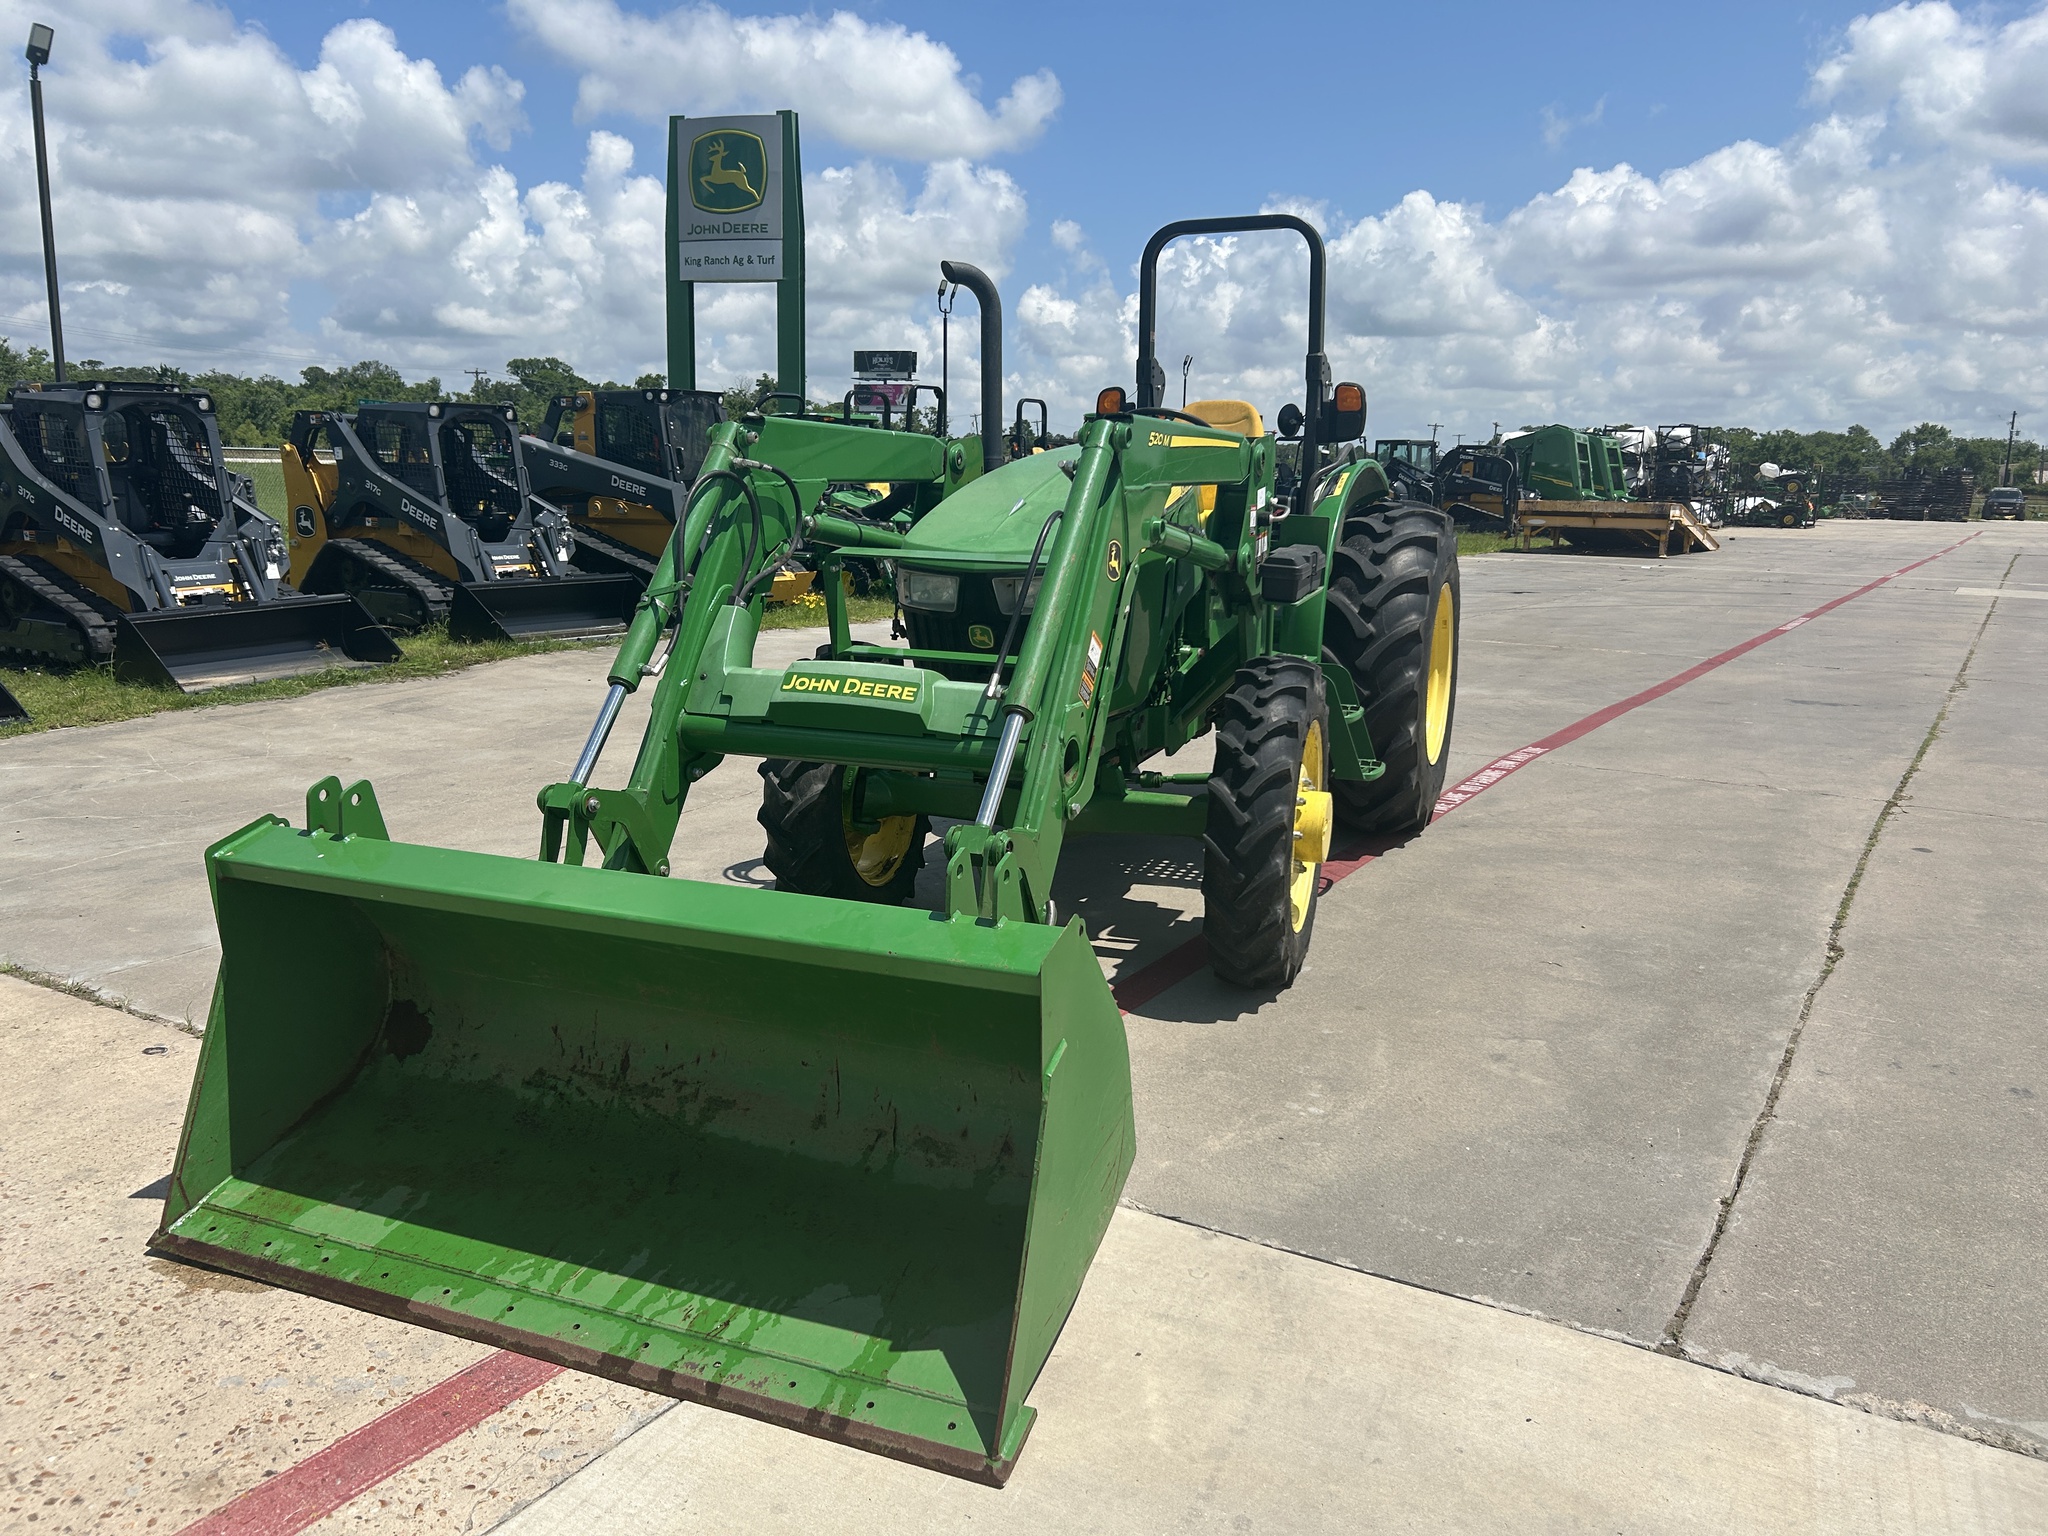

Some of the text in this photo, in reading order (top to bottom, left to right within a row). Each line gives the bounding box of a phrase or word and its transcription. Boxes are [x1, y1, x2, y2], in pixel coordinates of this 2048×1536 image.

[687, 222, 768, 235] JOHN DEERE
[684, 254, 776, 267] King Ranch Ag & Turf
[549, 459, 568, 471] 333G
[17, 485, 35, 504] 317G
[364, 480, 382, 496] 317G
[611, 475, 647, 497] DEERE
[401, 498, 438, 530] DEERE
[54, 505, 93, 544] DEERE
[782, 674, 918, 701] JOHN DEERE
